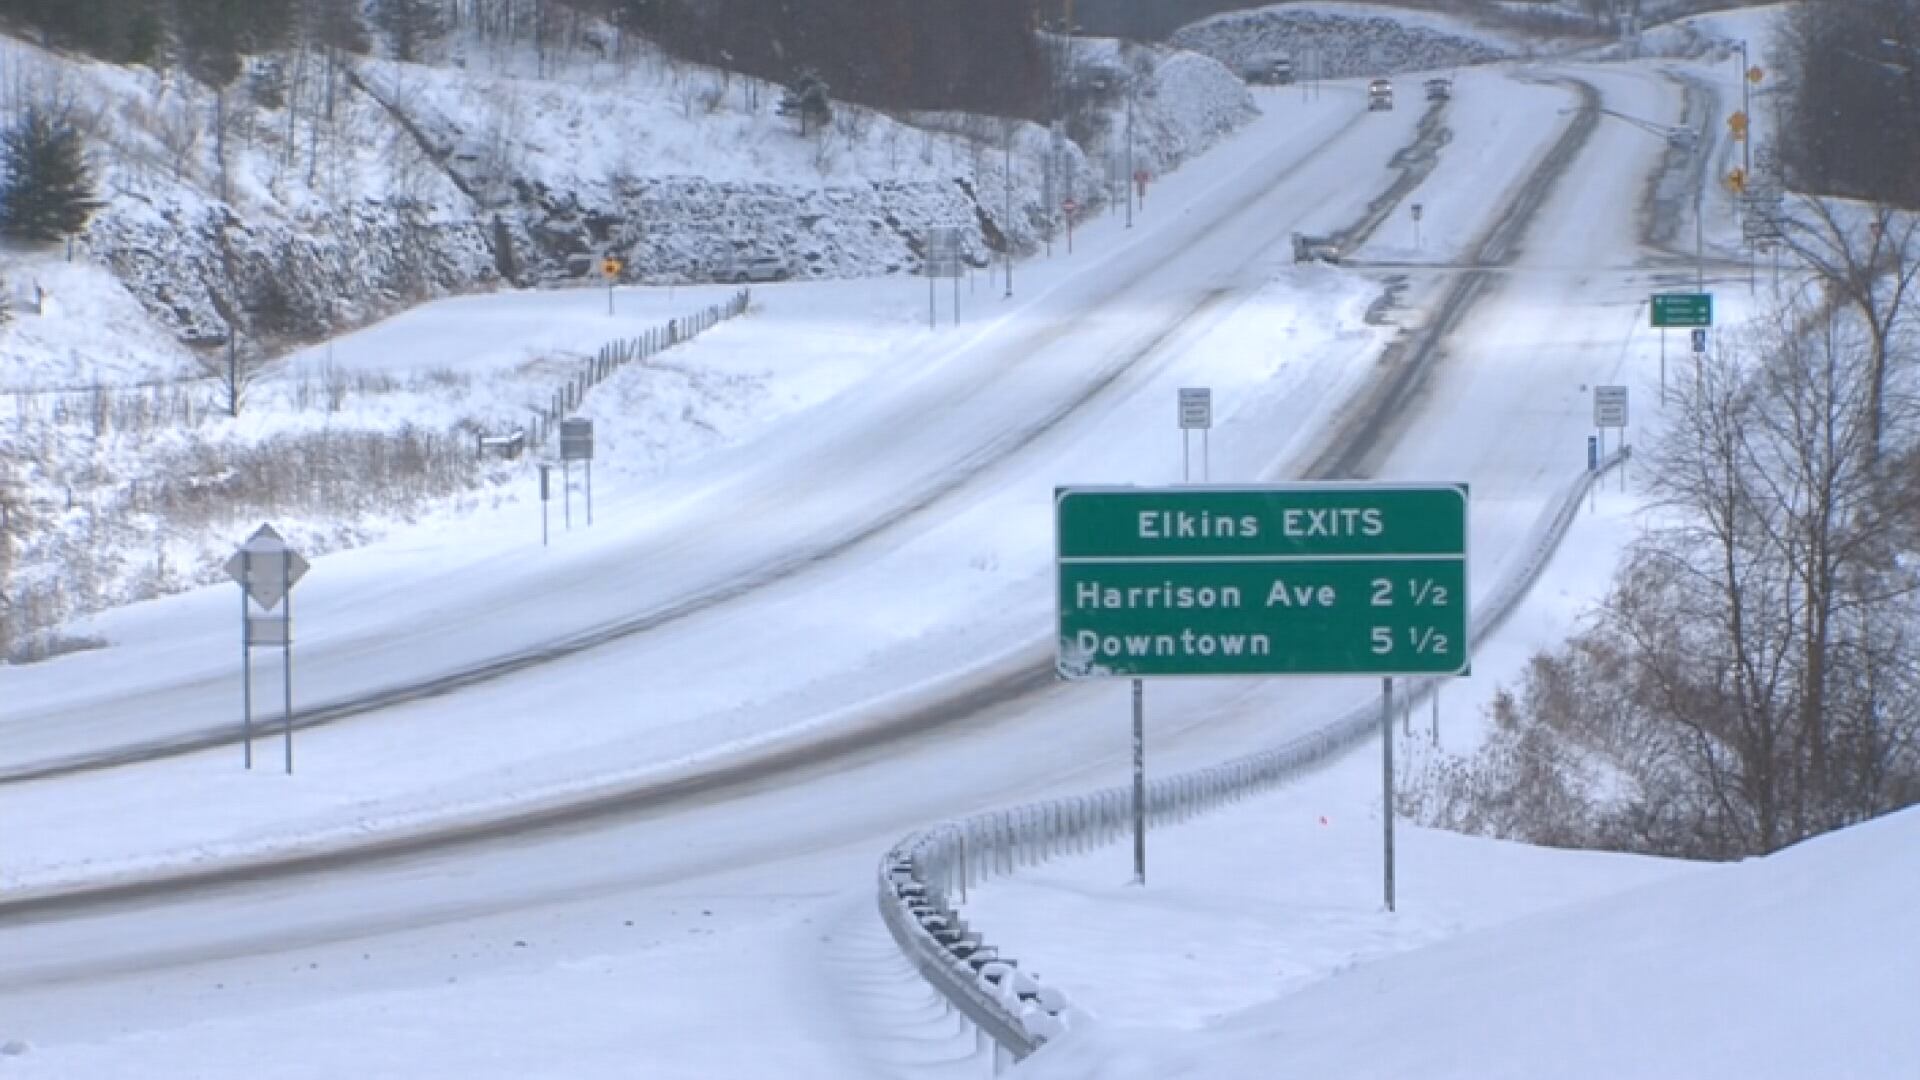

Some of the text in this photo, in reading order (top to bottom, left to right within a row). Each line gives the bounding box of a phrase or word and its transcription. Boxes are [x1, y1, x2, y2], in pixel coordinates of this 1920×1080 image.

[1138, 508, 1382, 538] Elkins EXITS
[1076, 581, 1240, 609] Harrison
[1266, 579, 1336, 607] Ave
[1371, 578, 1393, 606] 2
[1076, 630, 1269, 656] Downtown
[1371, 627, 1393, 655] 5
